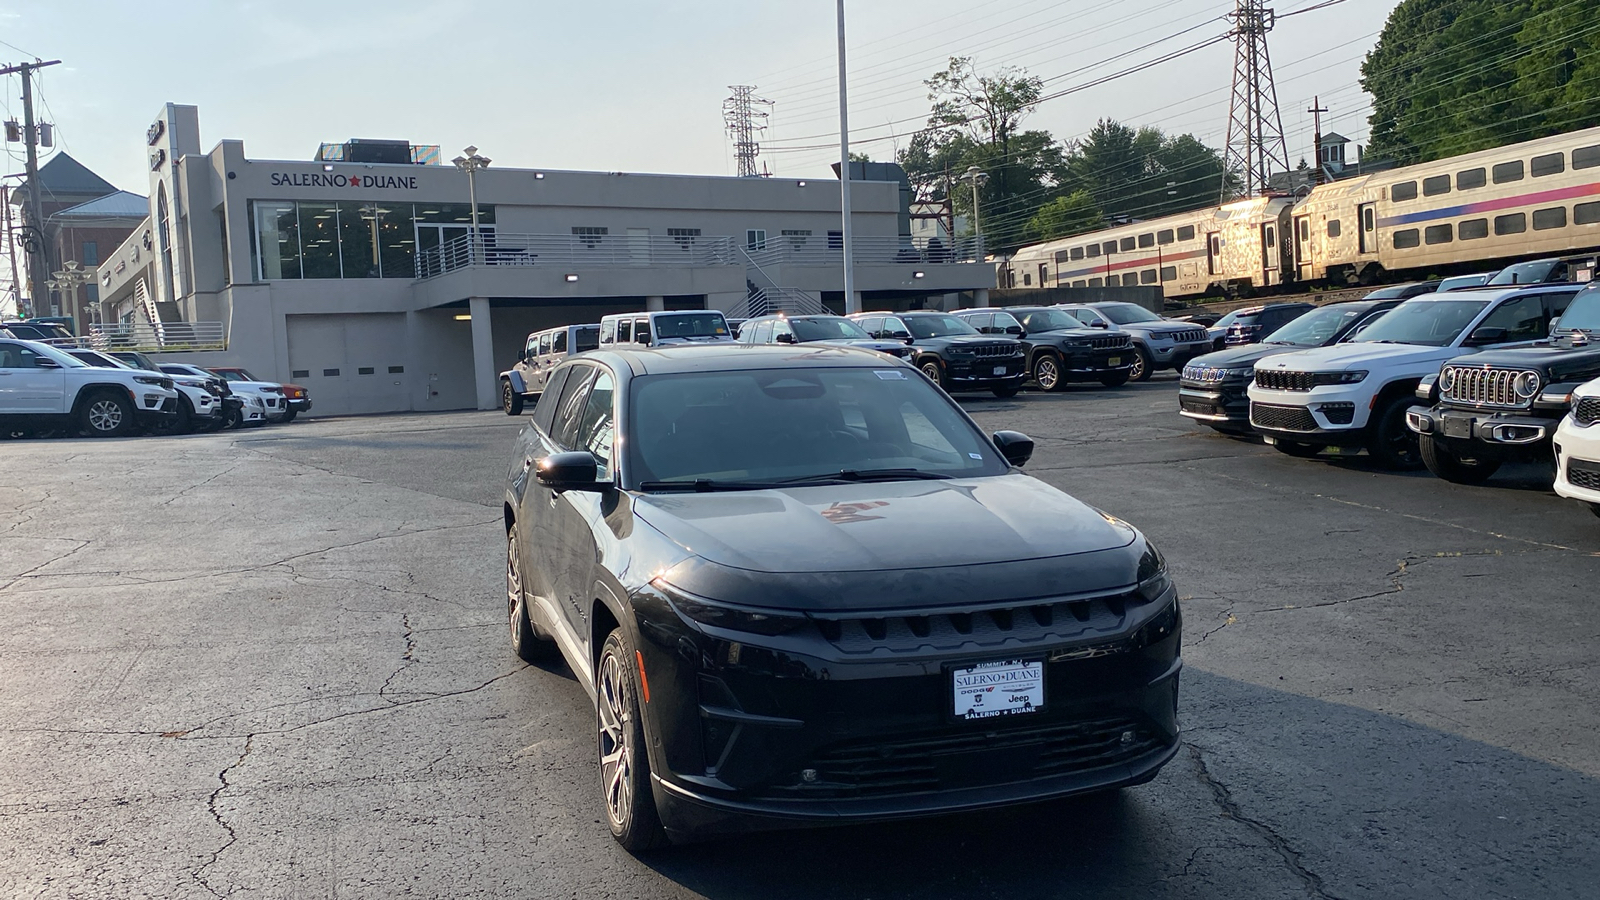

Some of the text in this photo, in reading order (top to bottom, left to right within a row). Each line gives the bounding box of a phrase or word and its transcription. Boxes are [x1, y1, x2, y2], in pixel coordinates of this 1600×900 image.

[271, 172, 418, 189] SALERNO DUANE
[956, 673, 1000, 687] SALERNO
[1006, 669, 1040, 680] DUANE
[1008, 695, 1029, 703] Jeep
[964, 706, 1036, 720] SALERNO DUANE
